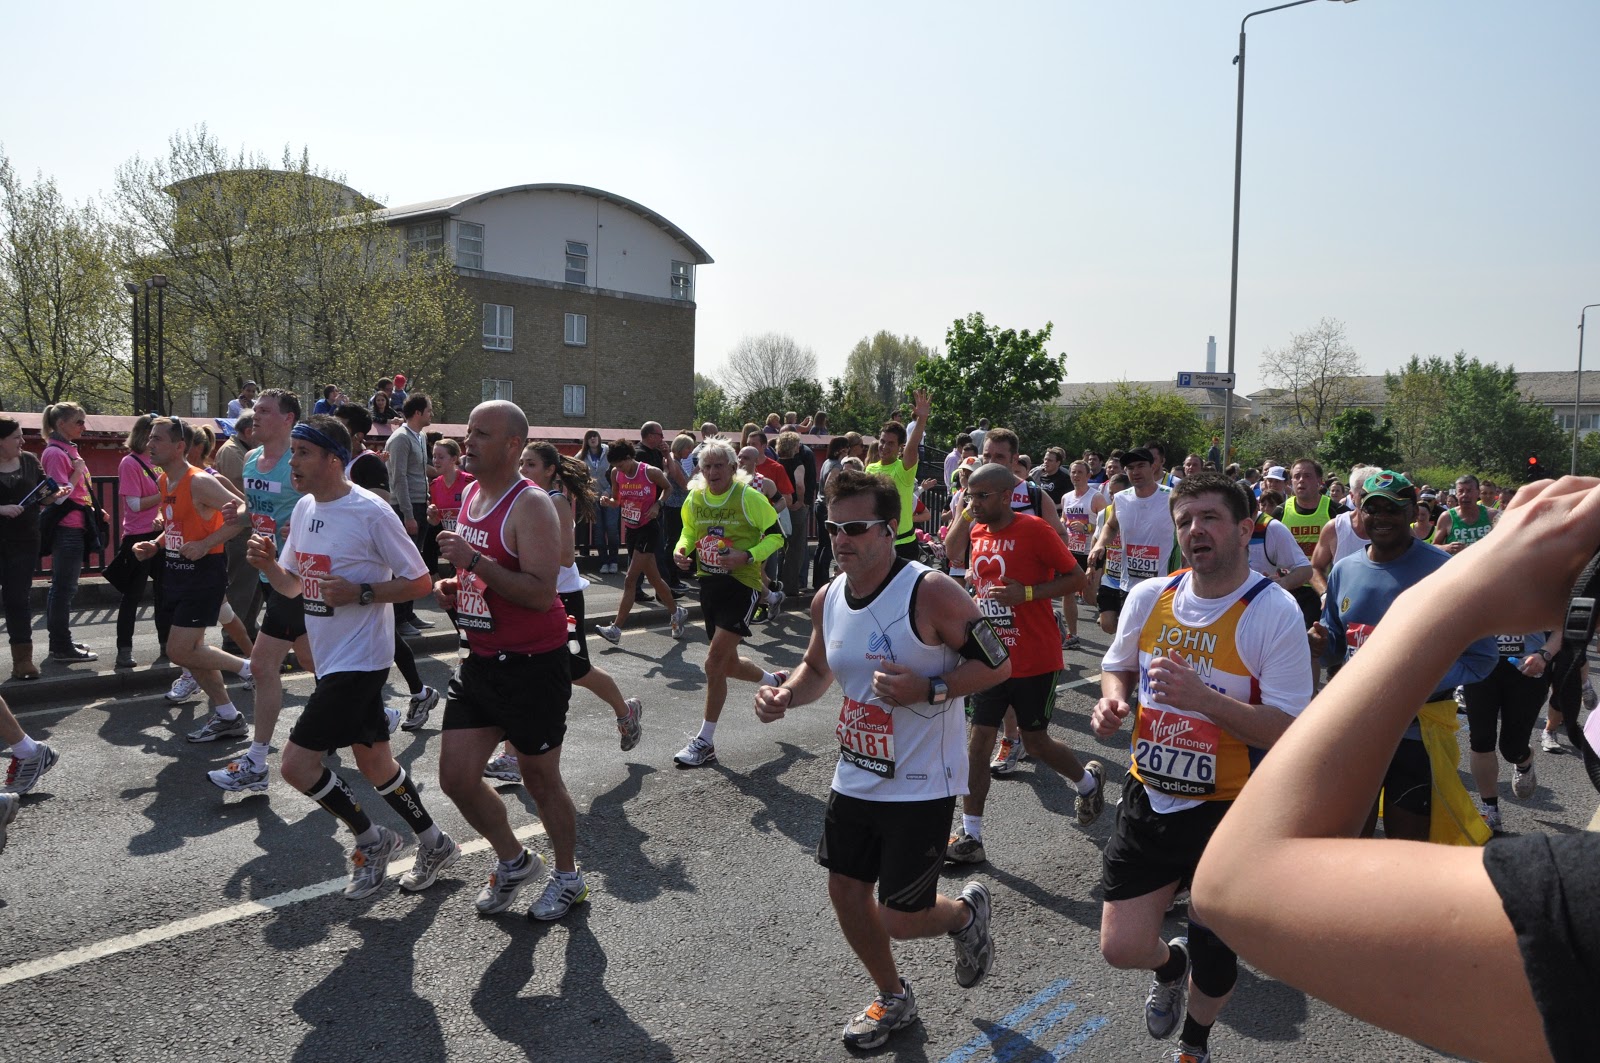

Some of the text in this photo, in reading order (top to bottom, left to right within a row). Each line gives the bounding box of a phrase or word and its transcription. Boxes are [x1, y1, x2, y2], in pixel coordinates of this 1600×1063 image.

[1181, 374, 1190, 385] P
[248, 478, 270, 491] TOM
[247, 494, 274, 513] Bliss
[1066, 507, 1084, 515] EVAN
[308, 519, 325, 533] JP
[973, 539, 1016, 553] ARUN
[1127, 557, 1157, 571] 56291
[469, 620, 491, 629] adidas
[1156, 624, 1218, 654] JOHN
[865, 653, 898, 661] SportsAid
[843, 698, 870, 727] Virgin
[858, 721, 889, 734] money
[1149, 711, 1194, 747] Virgin
[1175, 736, 1213, 751] money
[855, 758, 889, 773] adidas
[1136, 741, 1212, 783] 26776
[1161, 781, 1206, 794] adidas
